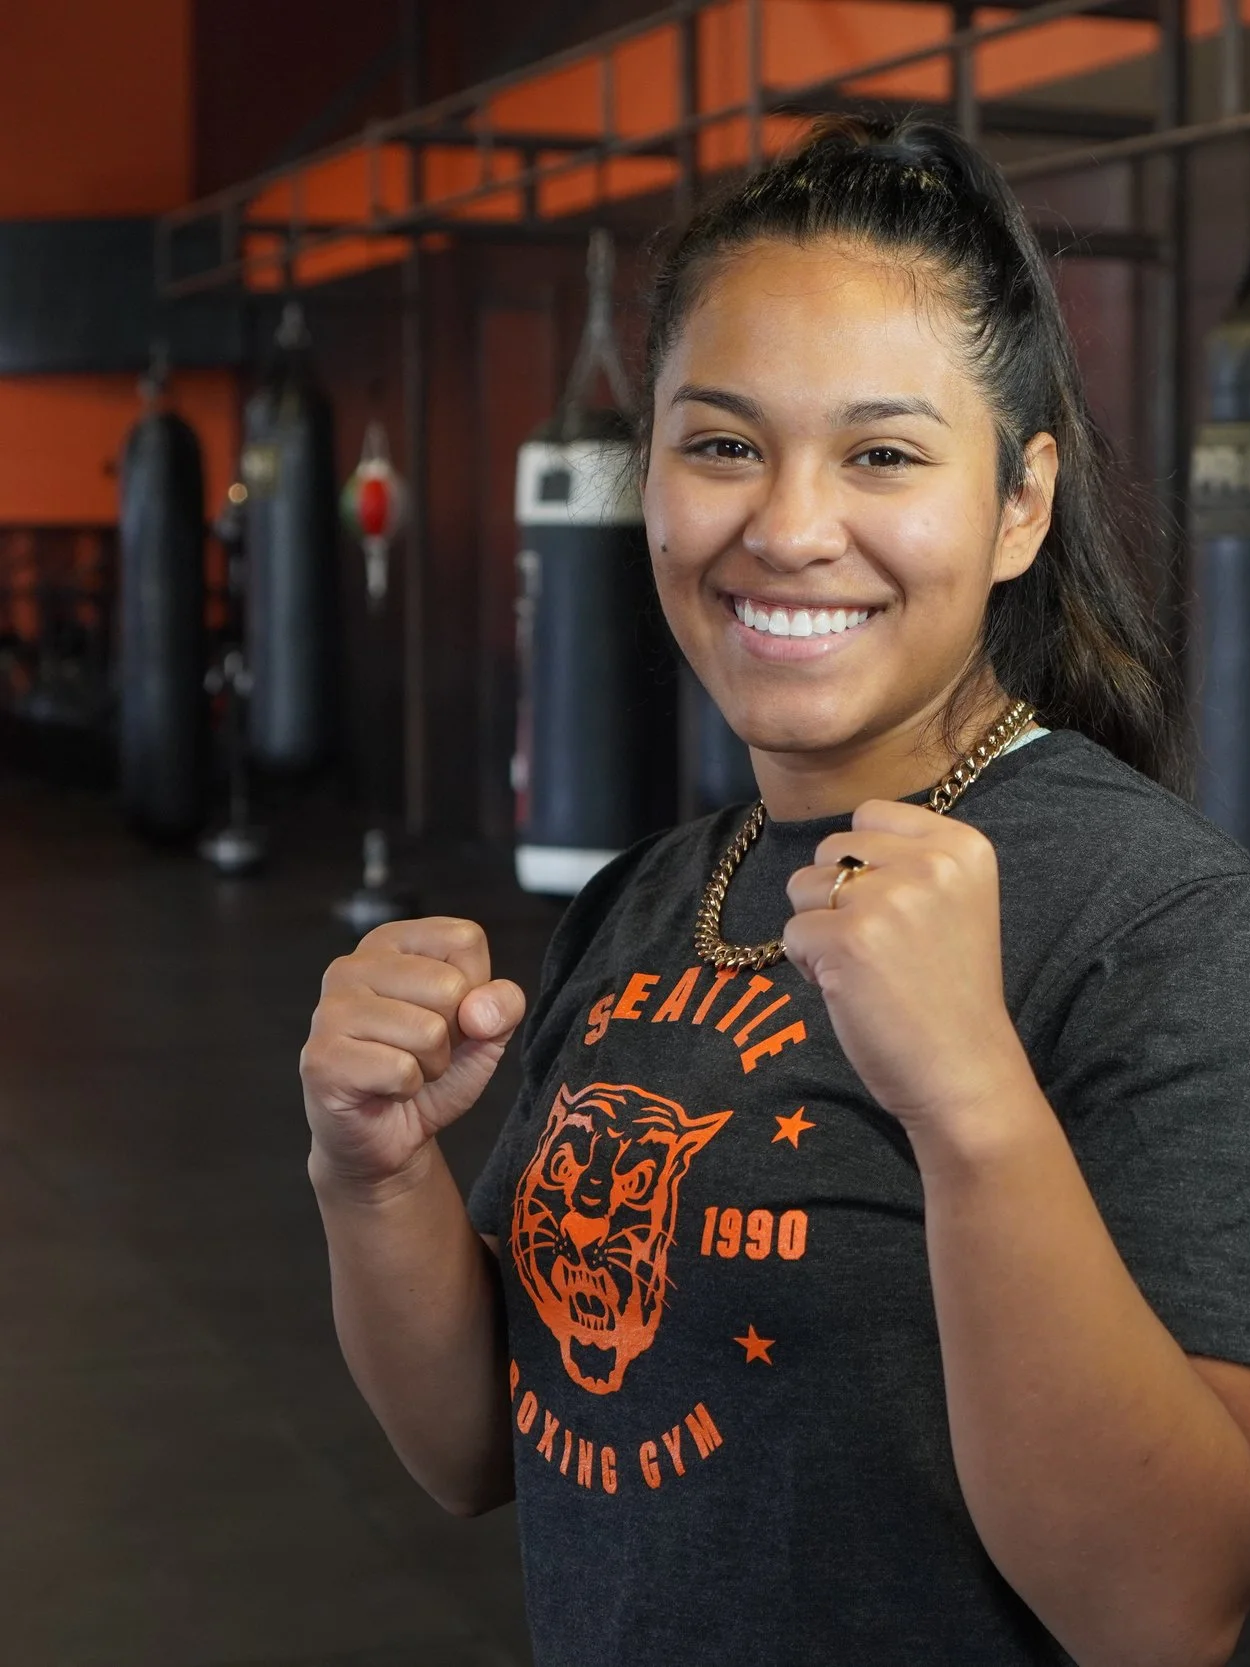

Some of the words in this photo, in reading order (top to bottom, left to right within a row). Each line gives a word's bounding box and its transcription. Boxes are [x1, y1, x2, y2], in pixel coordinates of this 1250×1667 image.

[584, 966, 807, 1075] SEATTLE
[700, 1206, 809, 1261] 1990
[639, 1402, 723, 1489] GYM
